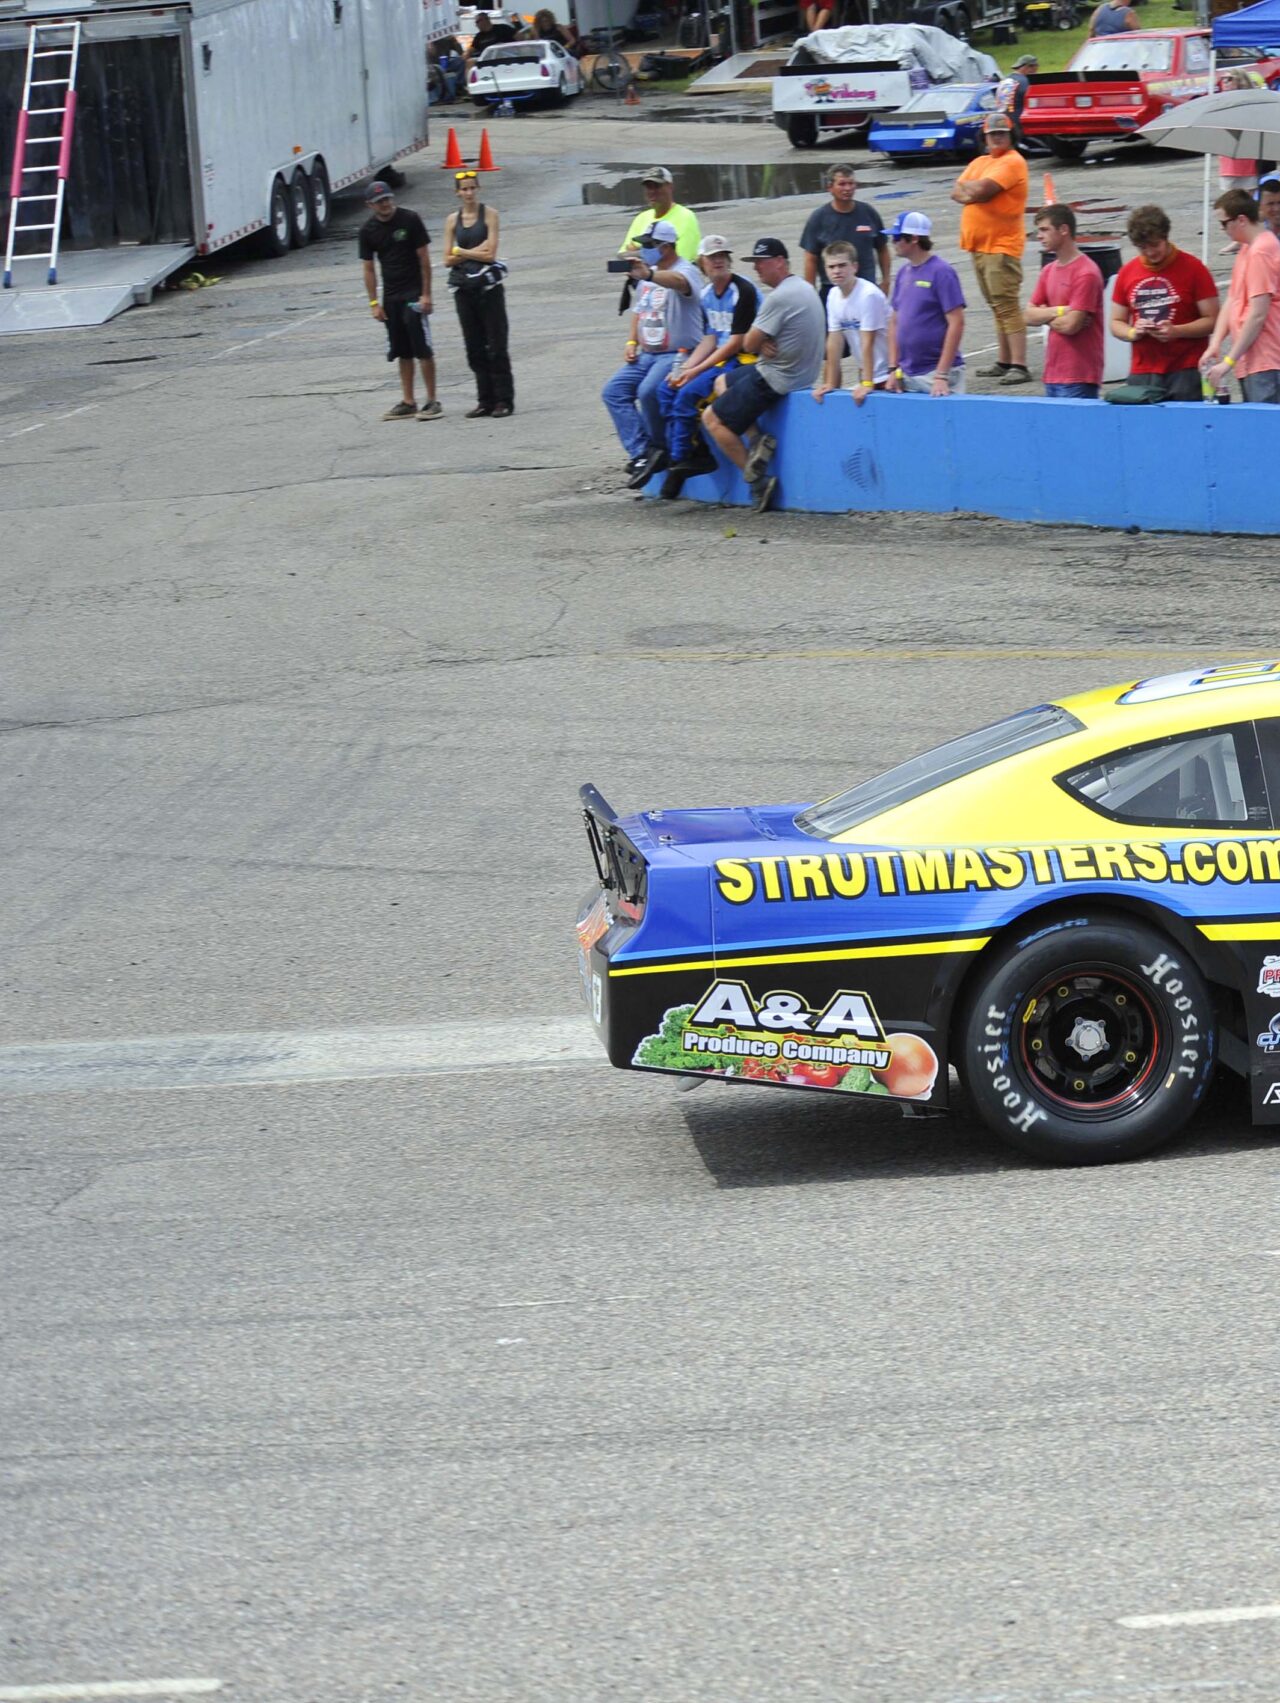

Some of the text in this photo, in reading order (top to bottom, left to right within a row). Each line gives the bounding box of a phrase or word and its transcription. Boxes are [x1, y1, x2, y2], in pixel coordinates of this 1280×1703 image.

[683, 1031, 891, 1069] Produce Company
[688, 980, 885, 1040] A&A
[1140, 953, 1201, 1080] Hoosier
[977, 1003, 1049, 1133] Hoosier
